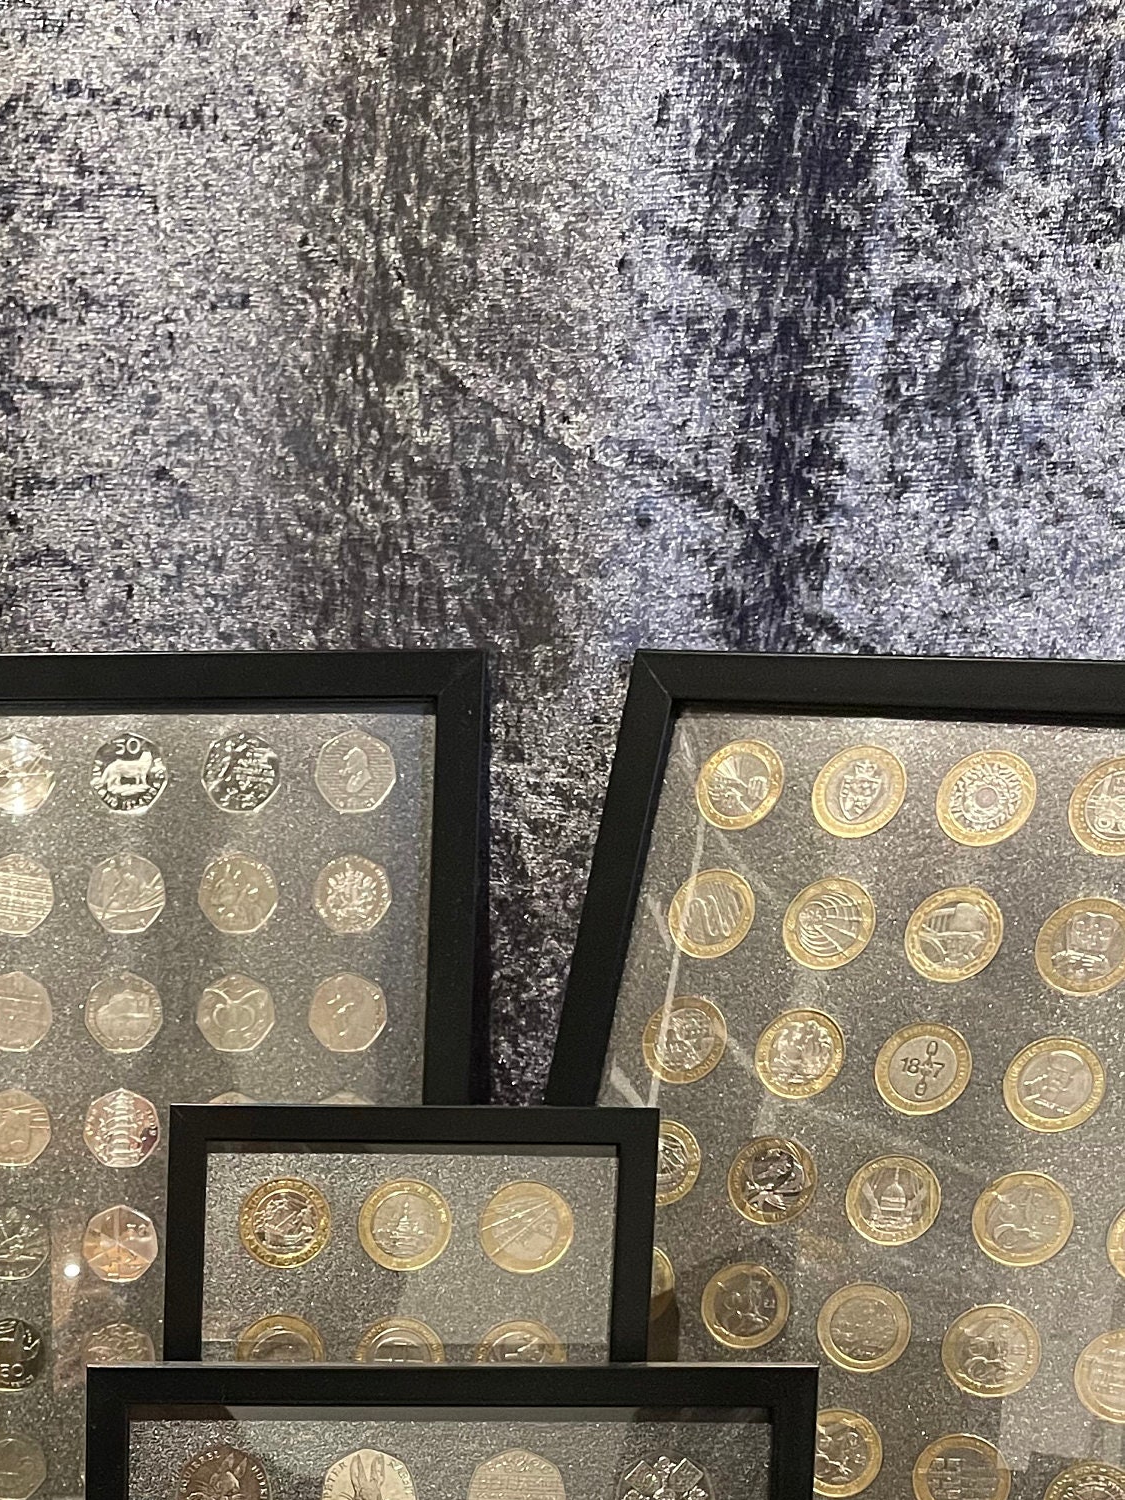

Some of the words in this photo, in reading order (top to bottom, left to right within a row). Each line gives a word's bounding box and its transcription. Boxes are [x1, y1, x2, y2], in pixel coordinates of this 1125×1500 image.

[111, 737, 142, 755] 50
[900, 1056, 946, 1079] 187
[0, 1363, 24, 1378] 50
